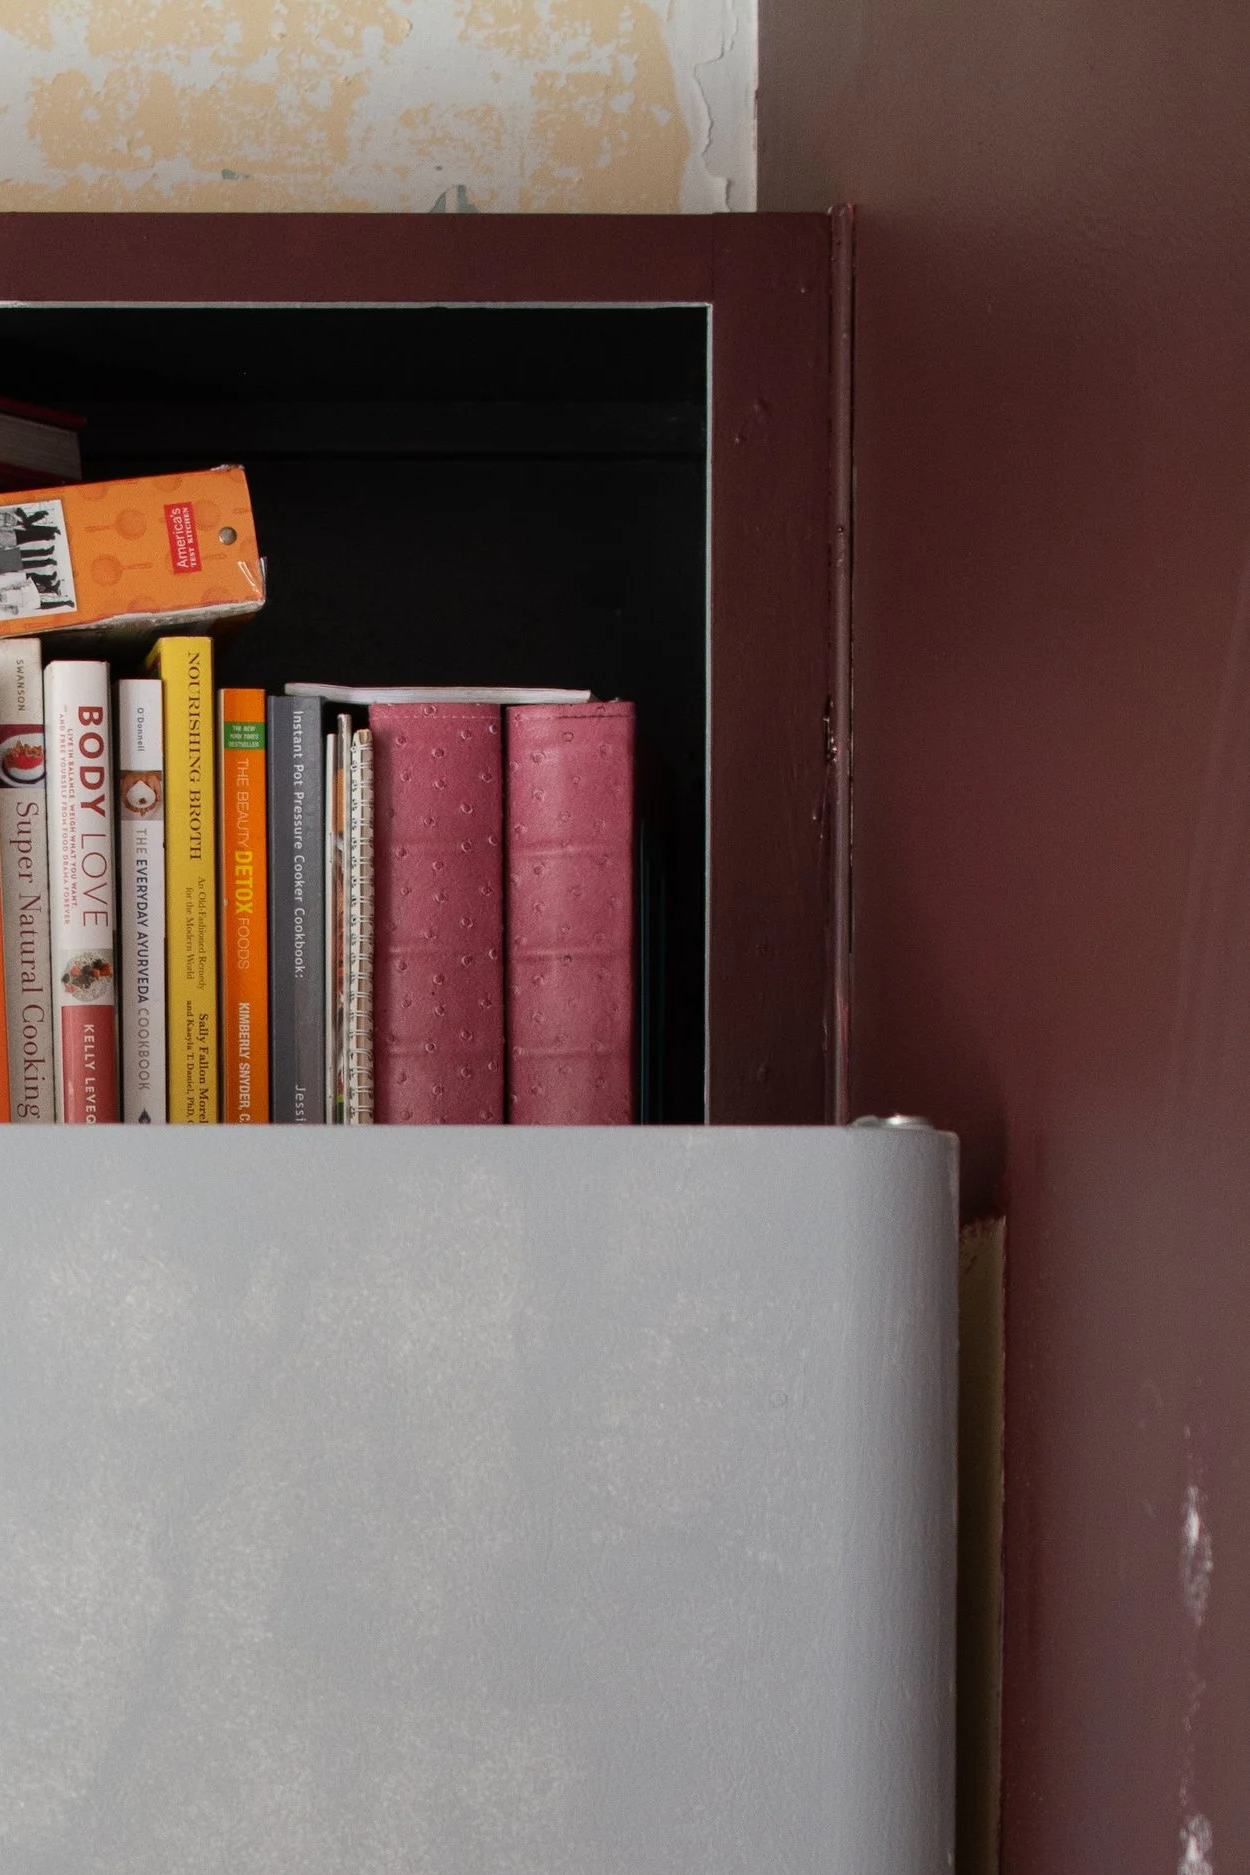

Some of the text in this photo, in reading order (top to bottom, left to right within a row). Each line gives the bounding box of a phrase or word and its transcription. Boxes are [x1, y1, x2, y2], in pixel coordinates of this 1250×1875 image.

[170, 507, 190, 568] America's
[182, 507, 197, 567] TEST KITCHEN
[15, 659, 25, 712] SWANSON
[68, 749, 74, 759] IN
[137, 707, 145, 752] O'Donnell
[188, 651, 203, 861] NOURISHING BROTH
[78, 706, 110, 927] BODY LOVE
[235, 758, 254, 969] THE BEAUTY DETOX FOODS
[293, 711, 306, 979] Instant Pot Pressure Cooker Cookbook:
[136, 828, 150, 1090] THE EVERYDAY AYURVEDA COOKBOOK
[185, 887, 195, 980] for the Modern World
[196, 875, 207, 991] An Old-Fashioned Remedy
[9, 801, 47, 1119] Super Natural Cooking
[186, 1000, 194, 1017] and
[198, 1013, 209, 1043] Sally
[238, 1002, 250, 1060] KIMBERLY
[84, 1023, 95, 1069] KELLY
[185, 1020, 195, 1051] Kaayla
[187, 1053, 195, 1061] T.
[186, 1063, 196, 1095] Daniel,
[199, 1046, 209, 1084] Fallon
[239, 1062, 250, 1111] SNYDER,
[187, 1097, 196, 1117] PhD,
